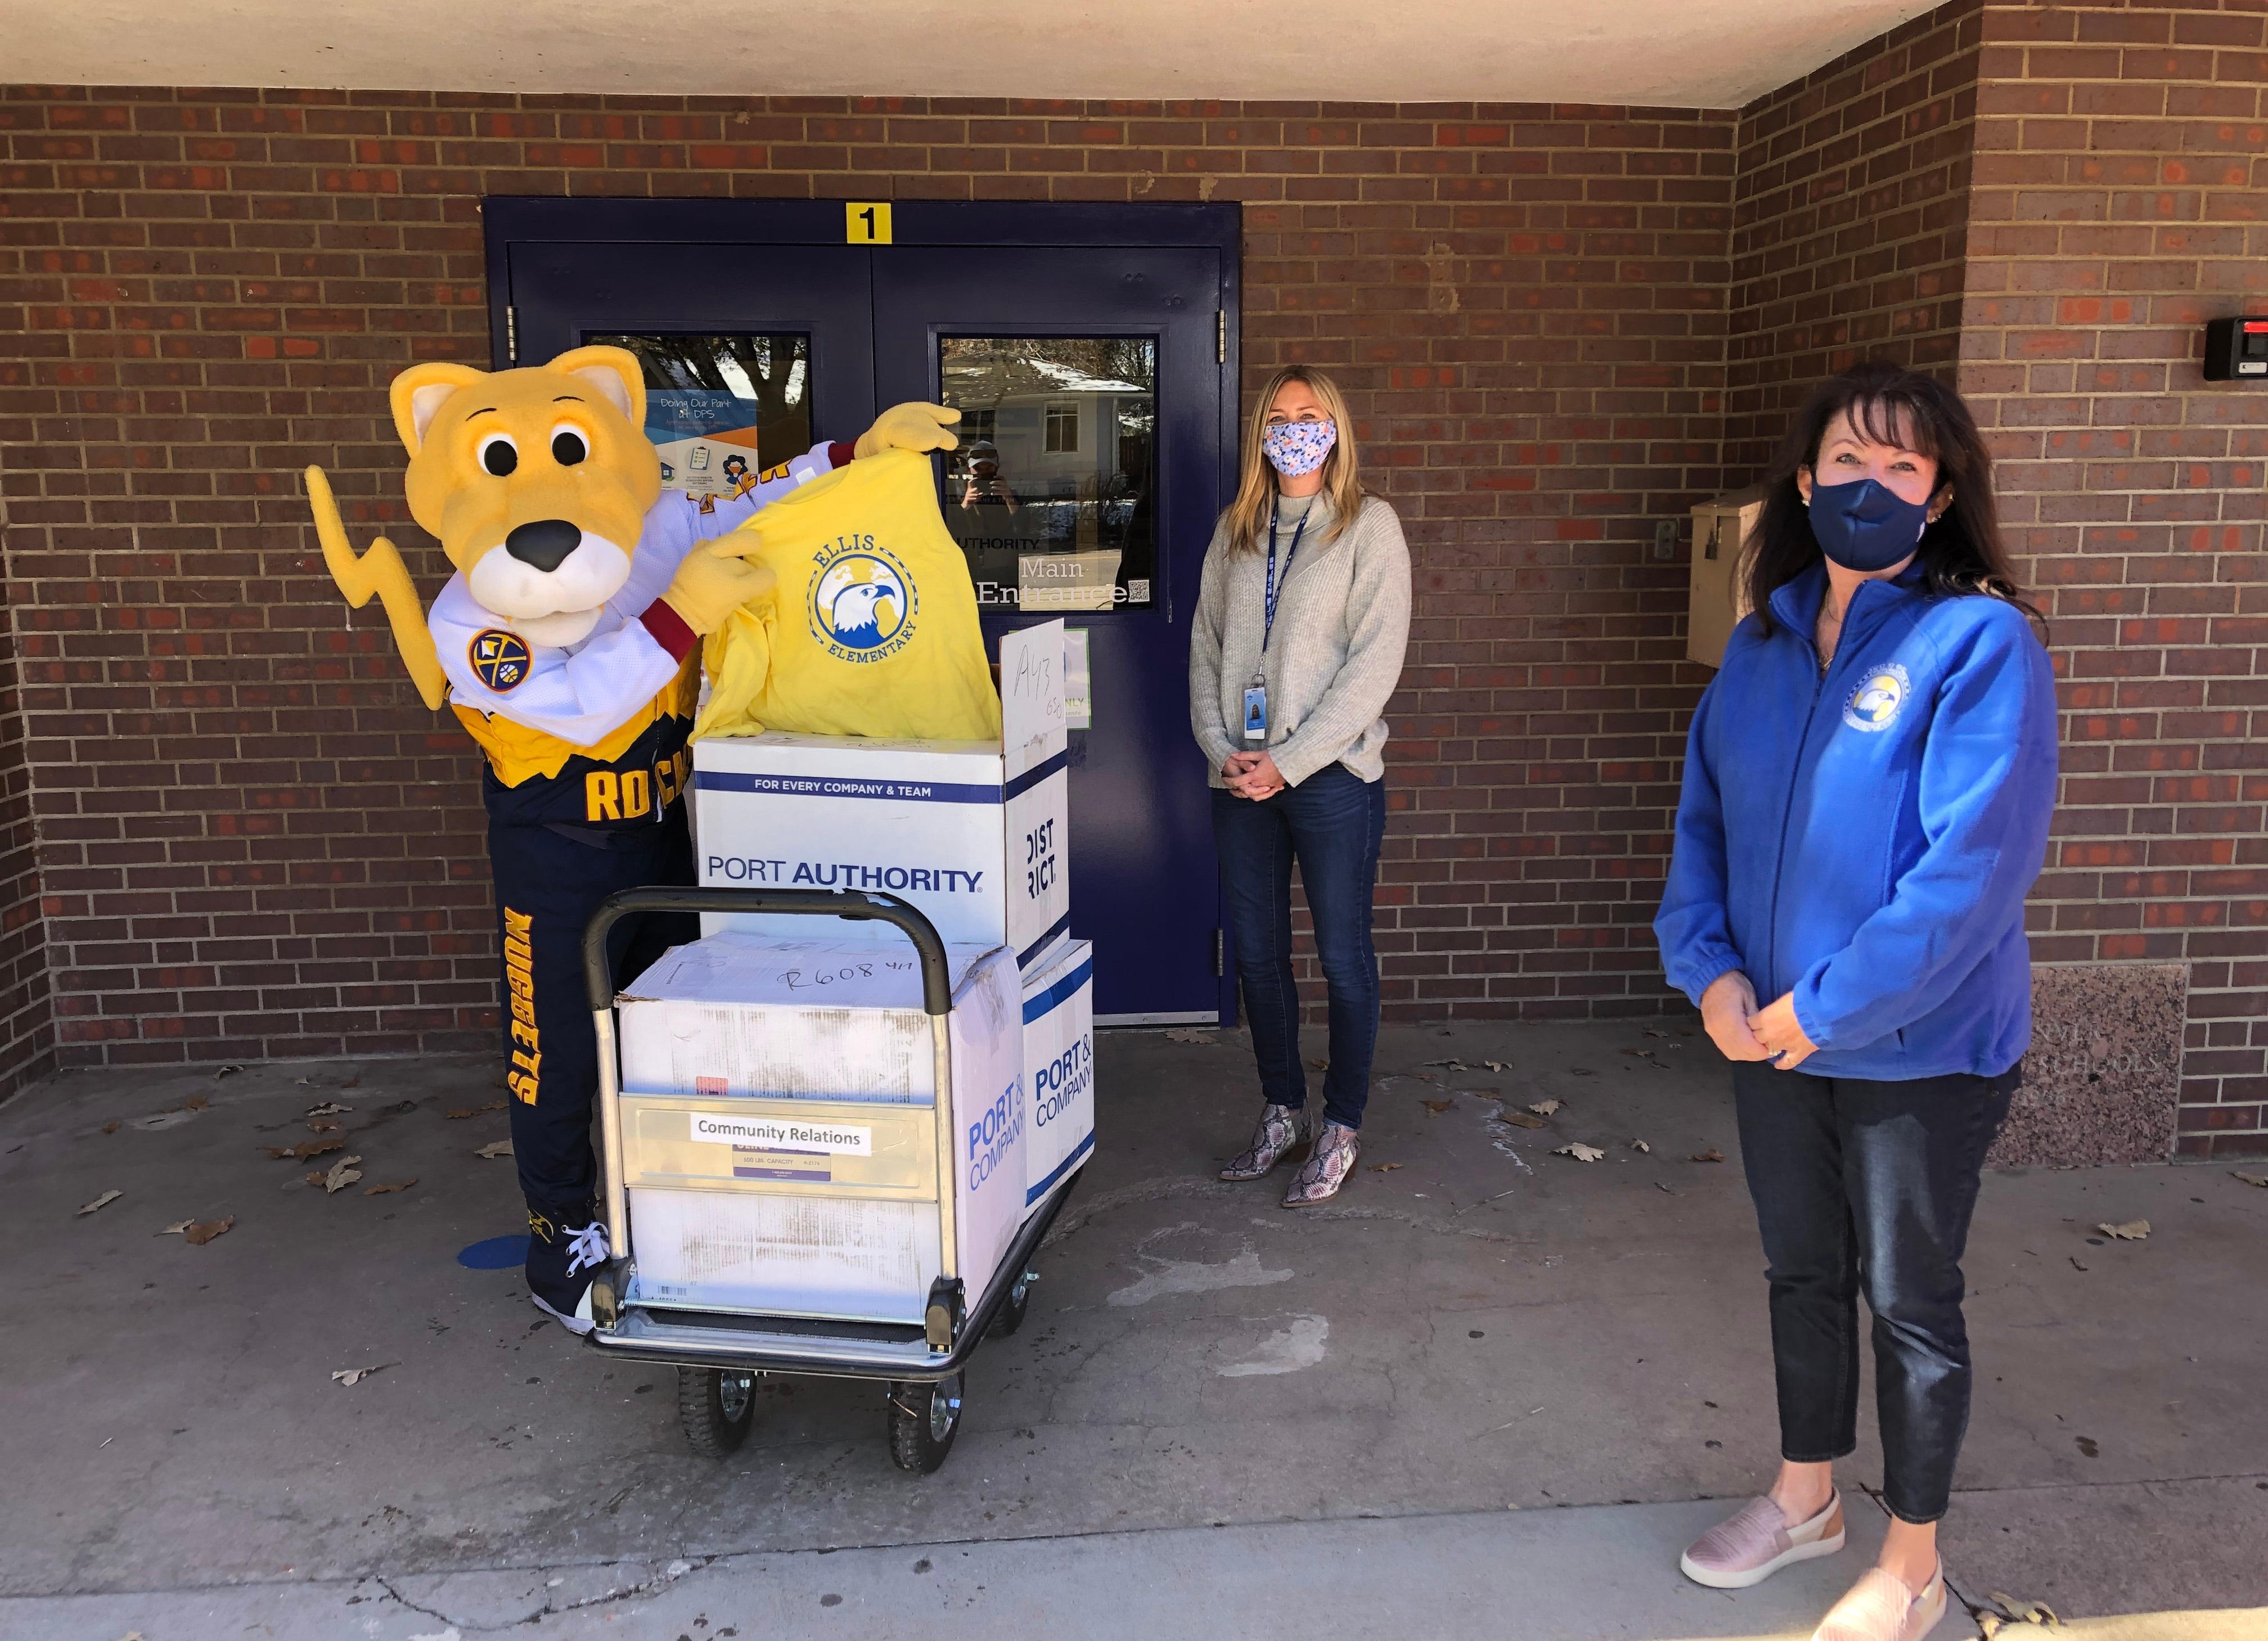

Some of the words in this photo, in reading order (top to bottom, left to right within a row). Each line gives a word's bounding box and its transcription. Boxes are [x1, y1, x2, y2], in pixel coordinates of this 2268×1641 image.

[860, 208, 875, 239] 1
[660, 398, 688, 411] Doing
[690, 398, 708, 408] Our
[711, 398, 732, 408] Part
[678, 409, 691, 418] at
[694, 409, 715, 419] DPS
[812, 534, 875, 569] ELLIS
[1020, 557, 1084, 578] Main
[976, 581, 1128, 604] Entrance
[827, 620, 917, 664] ELEMENTARY
[1065, 698, 1084, 707] NLY
[754, 778, 780, 791] FOR
[782, 780, 821, 793] EVERY
[823, 782, 884, 796] COMPANY
[886, 785, 895, 796] &
[897, 786, 932, 798] TEAM
[708, 856, 786, 882] PORT
[503, 905, 543, 1107] NUGGETS
[1036, 1039, 1081, 1102] PORT
[1082, 1033, 1091, 1062] &
[1036, 1061, 1091, 1128] COMPANY
[969, 1081, 1014, 1162] PORT
[1016, 1072, 1024, 1106] &
[698, 1119, 785, 1142] Community
[790, 1127, 861, 1146] Relations
[970, 1106, 1024, 1191] COMPANY
